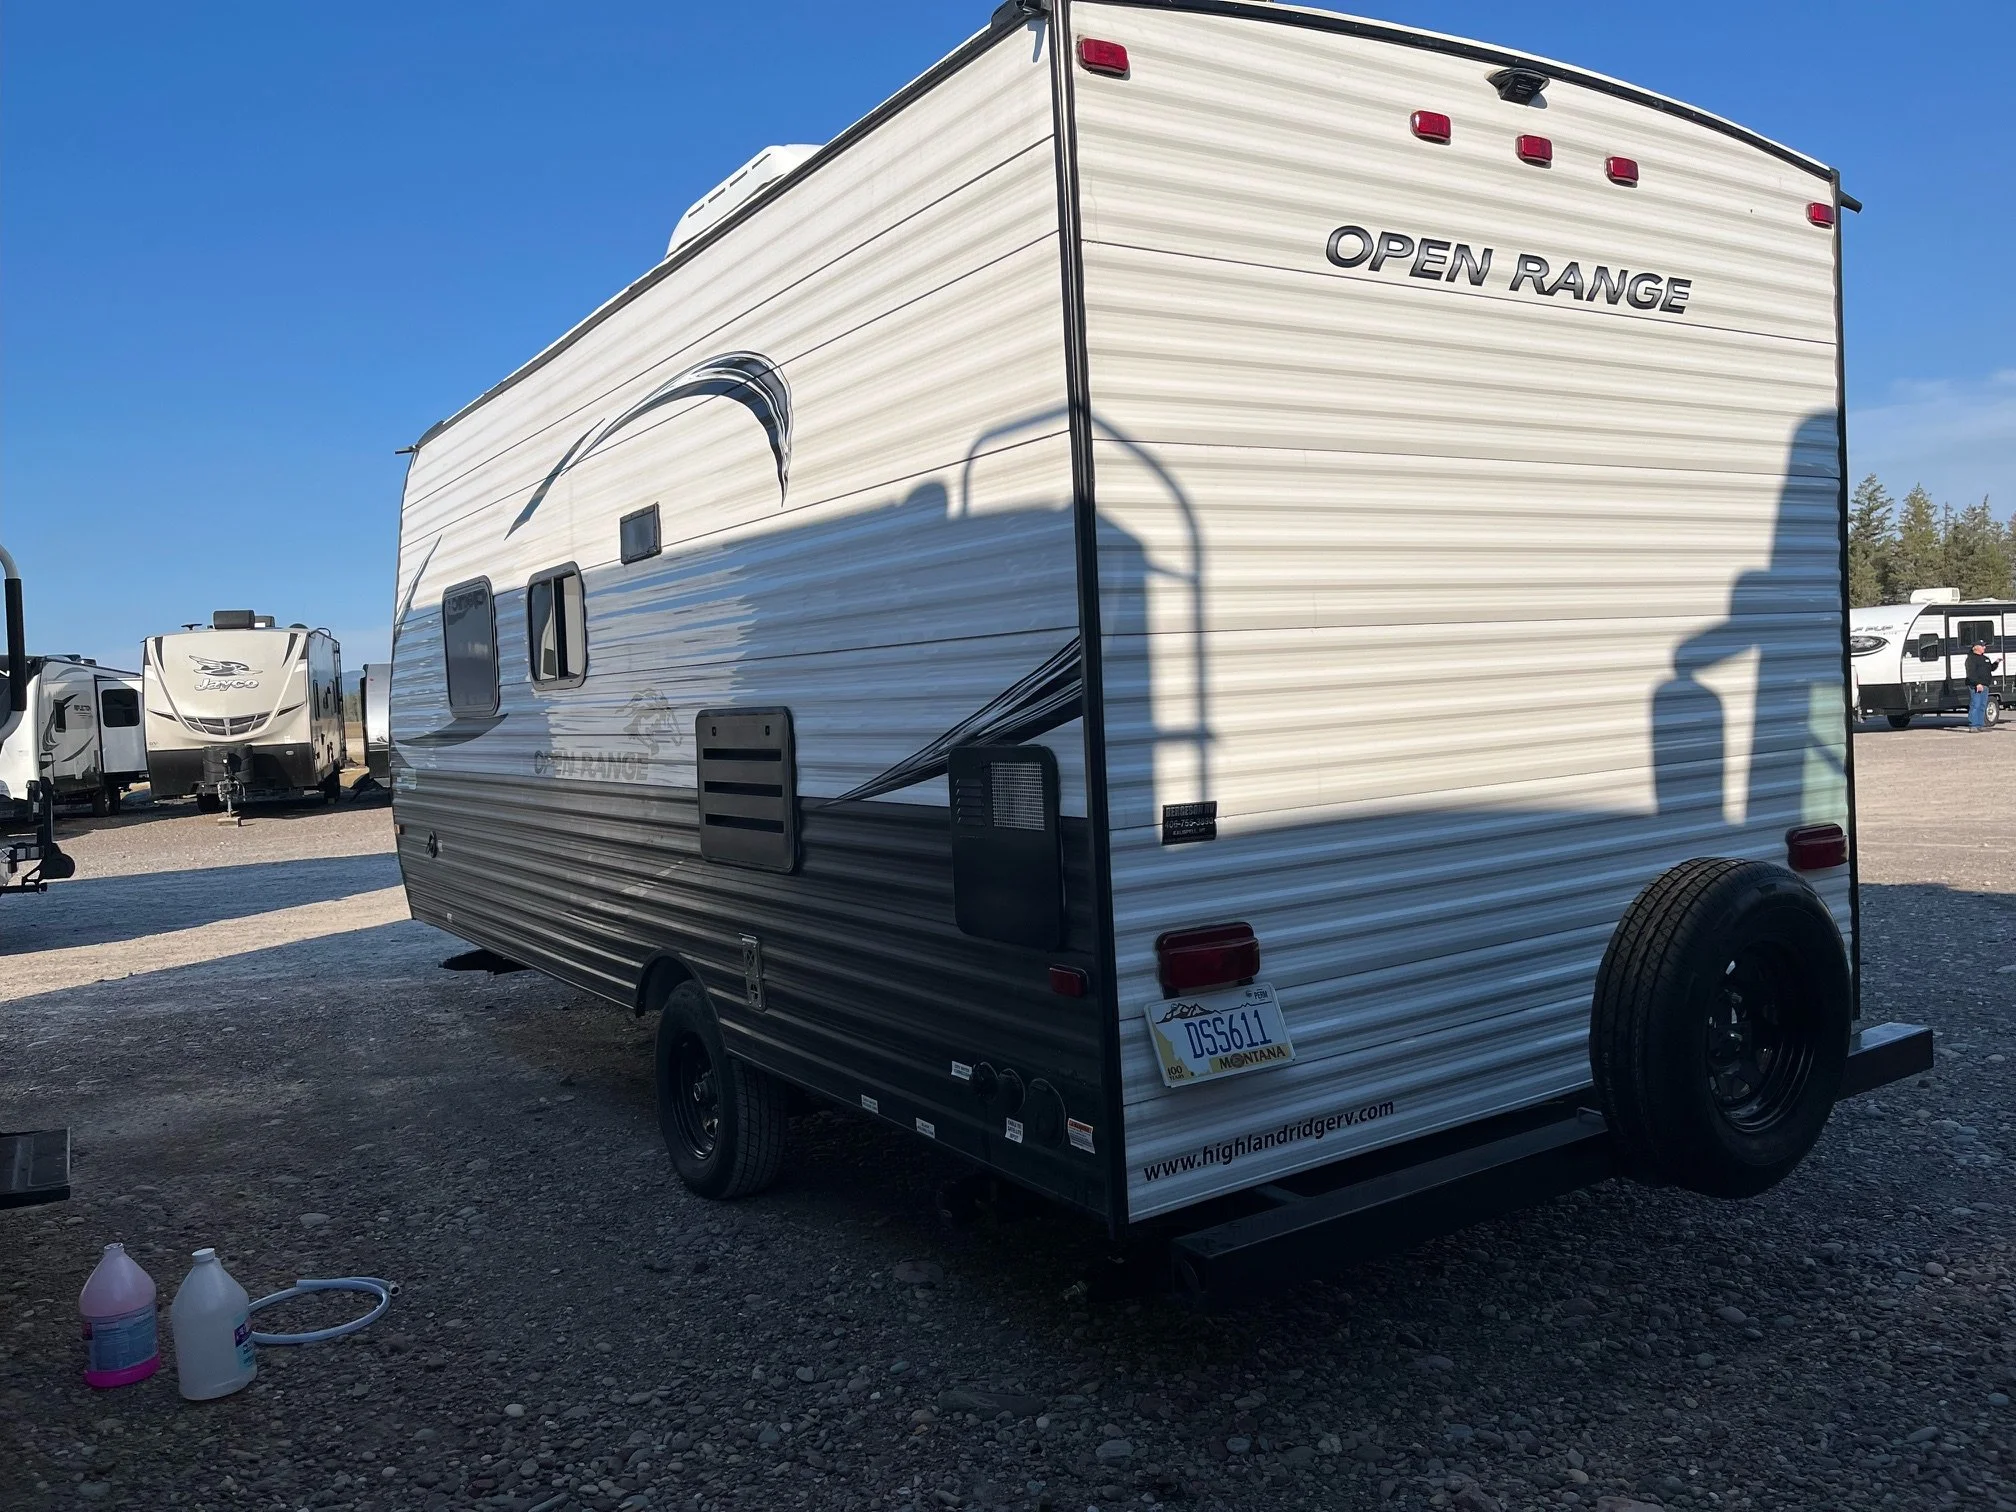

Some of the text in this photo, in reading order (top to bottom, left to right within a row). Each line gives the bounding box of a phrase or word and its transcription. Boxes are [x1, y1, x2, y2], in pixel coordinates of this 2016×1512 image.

[1325, 224, 1693, 315] OPEN RANGE
[194, 678, 260, 691] Jayco
[533, 748, 649, 781] OPEN RANGE
[1184, 1009, 1272, 1059] DSS611
[1167, 1065, 1183, 1076] 100
[1219, 1045, 1286, 1070] MONTANA
[1143, 1101, 1395, 1182] www.highlandridgerv.com
